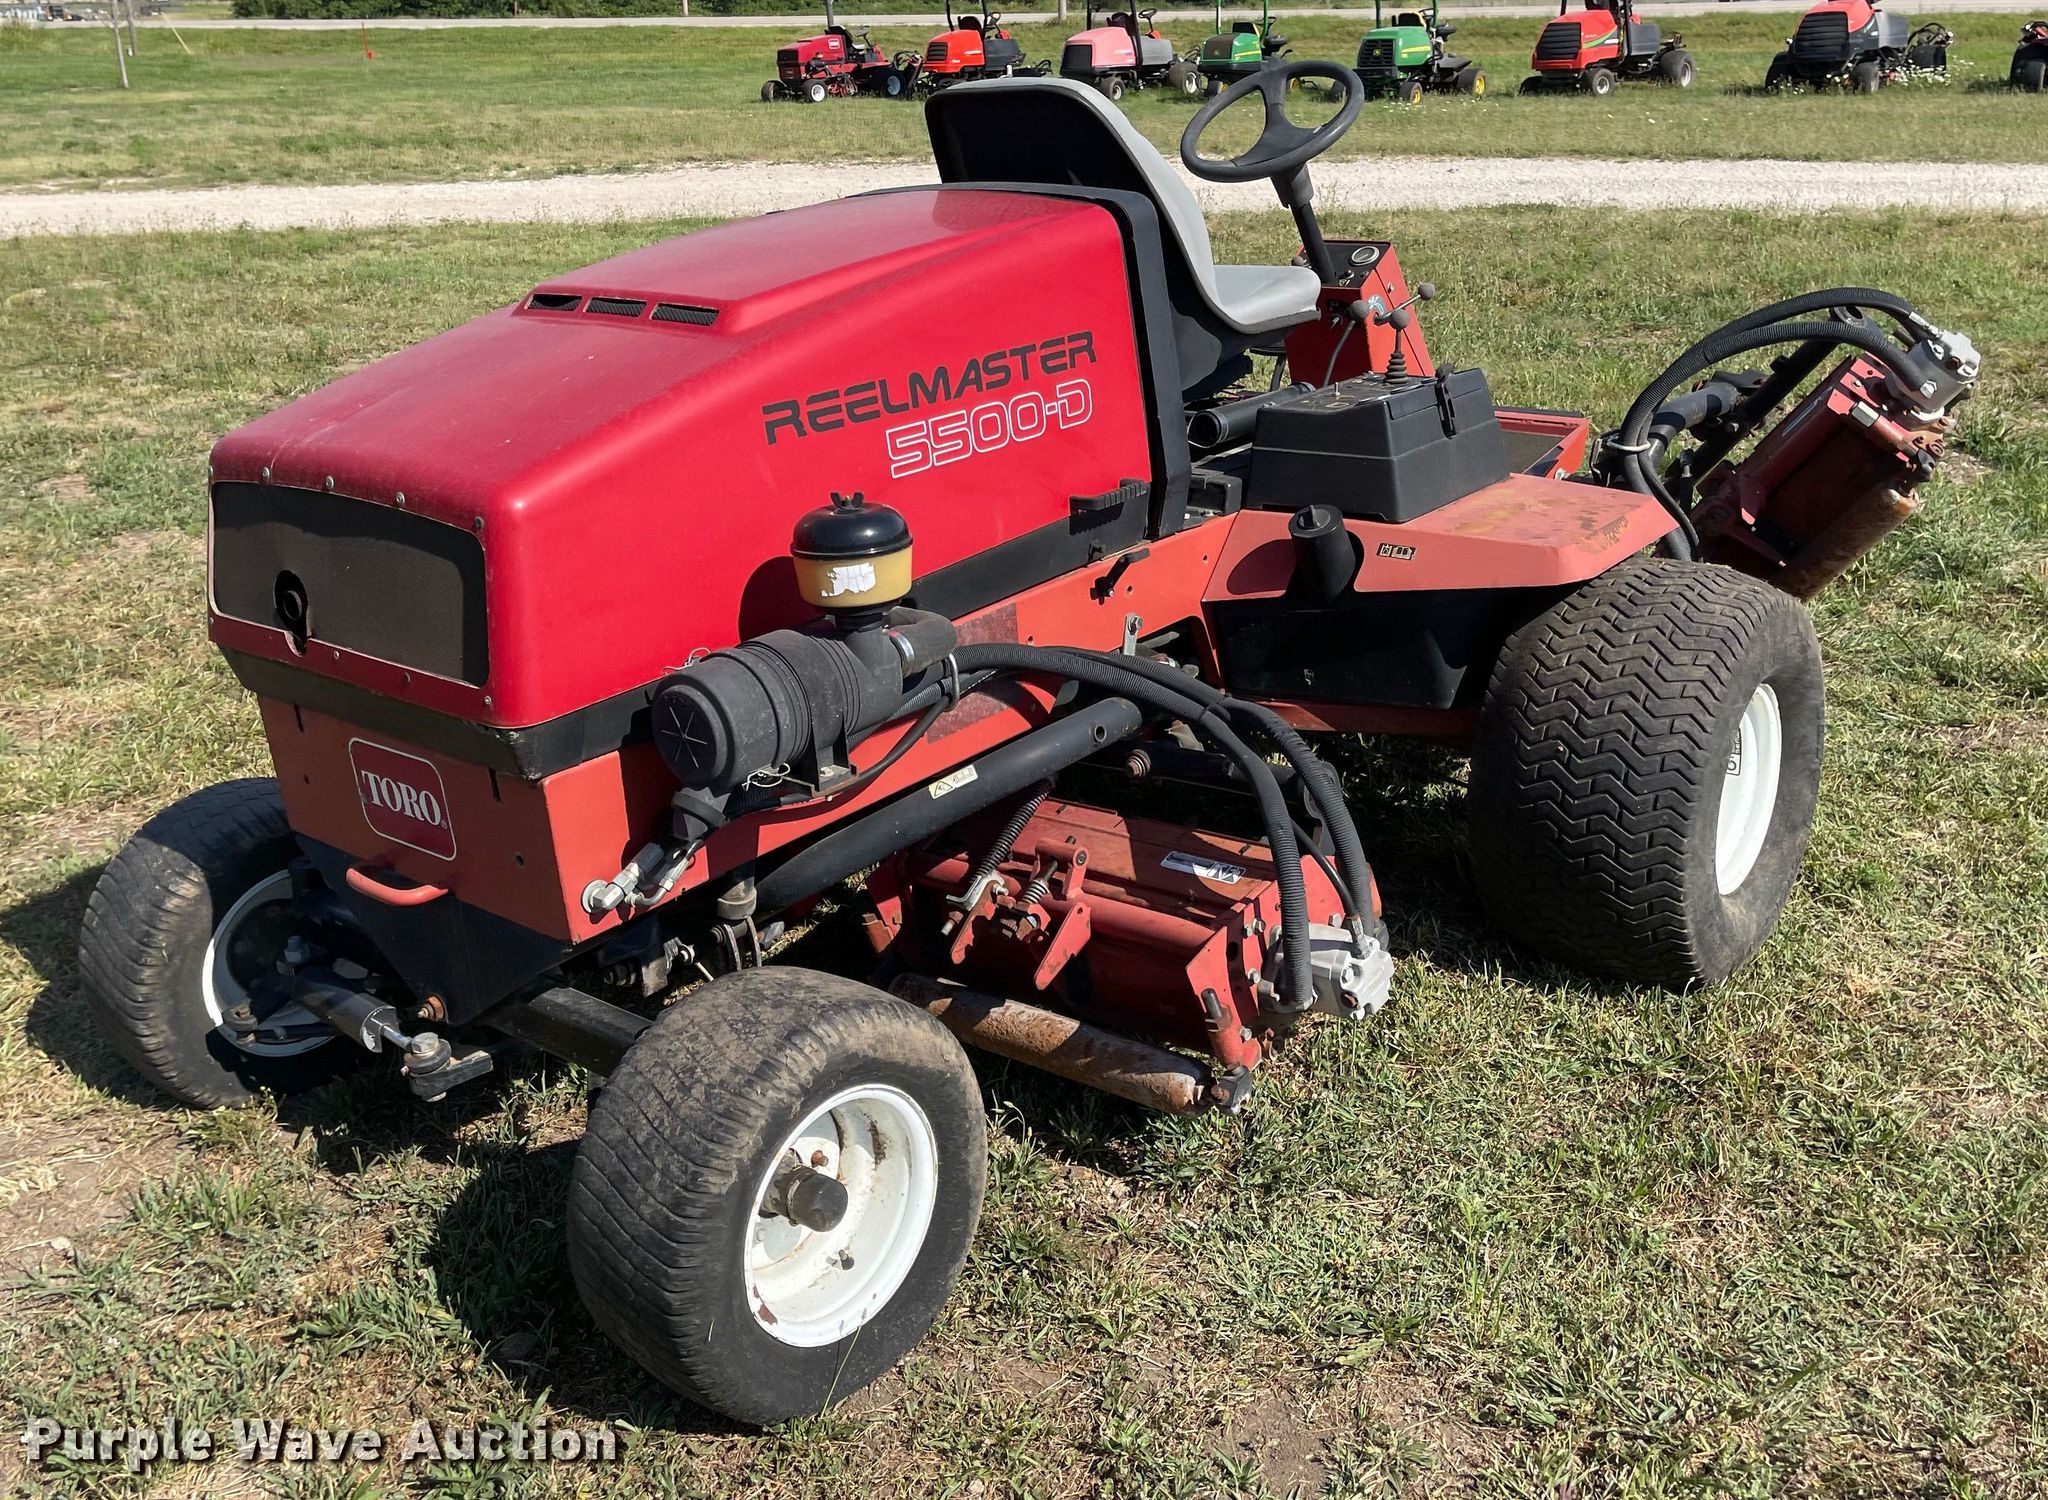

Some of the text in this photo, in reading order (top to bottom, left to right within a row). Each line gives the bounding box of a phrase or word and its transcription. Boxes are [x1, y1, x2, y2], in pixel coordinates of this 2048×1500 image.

[761, 331, 1097, 445] REELMASTER
[885, 379, 1093, 479] 5500-D
[361, 769, 442, 826] TORO
